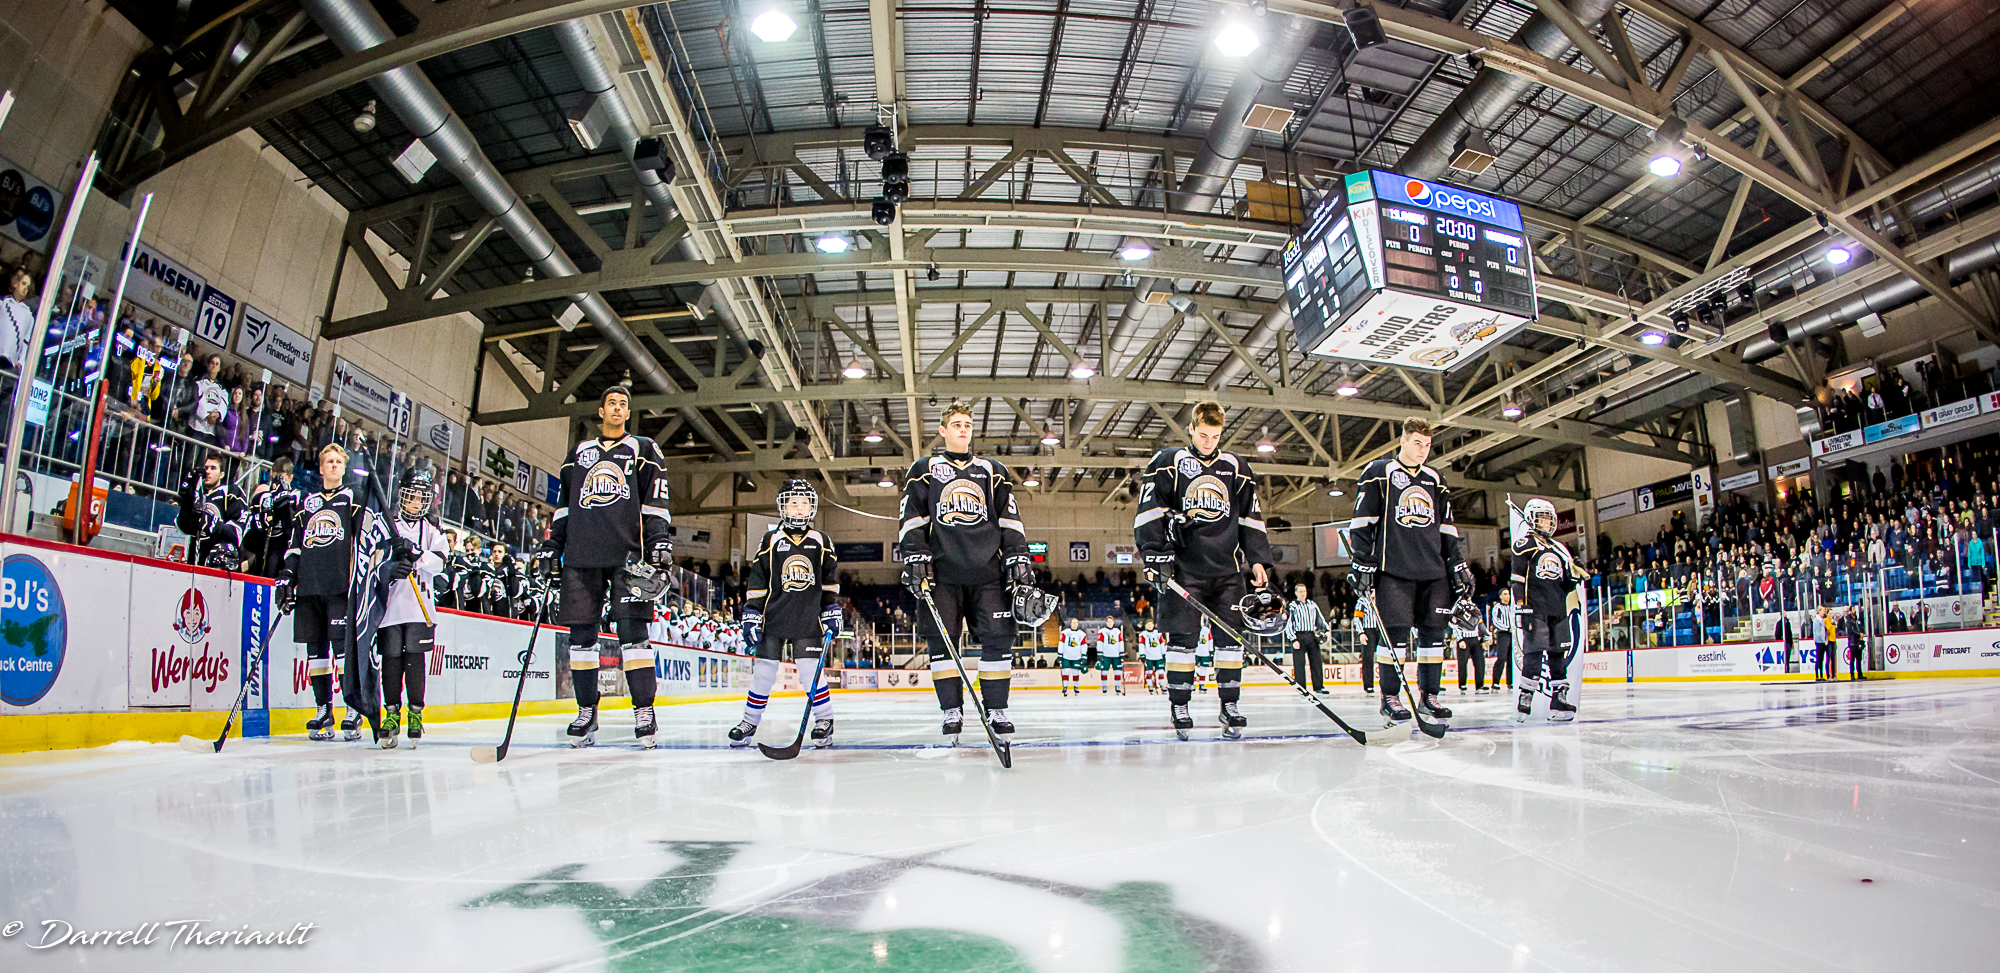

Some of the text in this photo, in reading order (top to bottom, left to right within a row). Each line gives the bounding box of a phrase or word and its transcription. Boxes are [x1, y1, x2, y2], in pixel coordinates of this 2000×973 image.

[1349, 183, 1370, 195] KENT
[1435, 191, 1495, 218] pepsi
[1353, 207, 1375, 220] KIA
[1410, 225, 1421, 243] 0
[1436, 217, 1477, 241] 20:00
[1362, 218, 1380, 284] DISCOVER
[1408, 244, 1433, 255] PENALTY
[1449, 240, 1470, 250] PERIOD
[1506, 247, 1517, 265] 0
[1505, 265, 1527, 276] PENALTY
[1450, 275, 1459, 289] 0
[1474, 280, 1483, 294] 0
[208, 295, 230, 312] SECTION
[1449, 290, 1482, 302] TEAM FOULS
[151, 287, 196, 322] electric
[204, 307, 226, 340] 19
[1360, 315, 1413, 347] PROUD
[1370, 305, 1458, 360] SUPPORTERS
[1421, 335, 1438, 344] OF
[272, 333, 301, 357] Freedom
[266, 344, 296, 366] Financial
[353, 380, 370, 393] Island
[1938, 408, 1954, 419] GRAY
[1954, 403, 1975, 414] GROUP
[392, 408, 409, 433] 18
[1828, 432, 1852, 446] LIVINGSTON
[1829, 443, 1843, 453] STEEL
[624, 460, 634, 476] C
[1776, 463, 1801, 475] KROWN
[518, 472, 528, 491] 17
[653, 478, 669, 500] 15
[1694, 474, 1702, 490] 8
[580, 482, 630, 499] ISLANDERS
[1139, 483, 1156, 504] 12
[90, 499, 101, 515] G
[936, 500, 988, 518] ISLANDERS
[1182, 496, 1230, 514] ISLANDERS
[1643, 495, 1650, 509] 9
[1395, 505, 1435, 521] ISLANDERS
[903, 554, 932, 565] CCM
[1072, 549, 1087, 560] 13
[1145, 554, 1175, 563] CCM
[1352, 562, 1377, 573] CCM
[1, 577, 49, 612] BJ's
[992, 611, 1011, 619] CC
[1697, 650, 1727, 661] eastlink
[1942, 647, 1971, 655] TIRECRAFT
[17, 657, 53, 672] Centre
[151, 641, 229, 694] Wendy's
[444, 654, 490, 671] TIRECRAFT
[663, 658, 691, 681] KAYS
[1583, 661, 1609, 671] FITNESS
